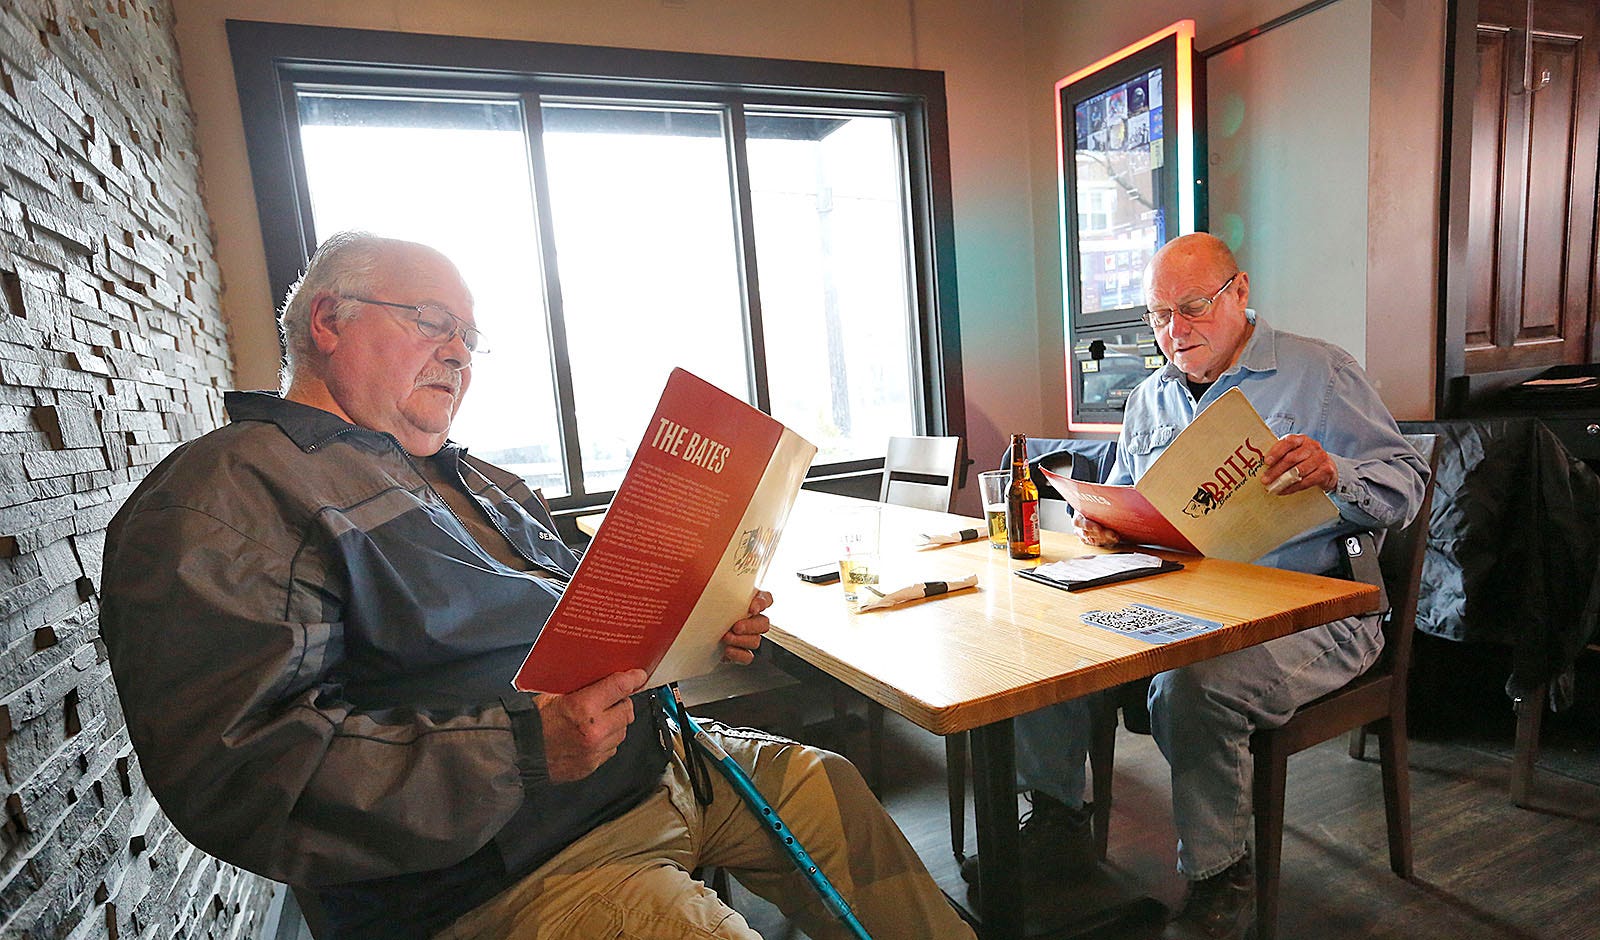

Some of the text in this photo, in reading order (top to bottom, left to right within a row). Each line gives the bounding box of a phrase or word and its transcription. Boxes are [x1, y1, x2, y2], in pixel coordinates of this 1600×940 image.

[652, 417, 731, 474] THE BATES
[1201, 437, 1264, 502] BATES
